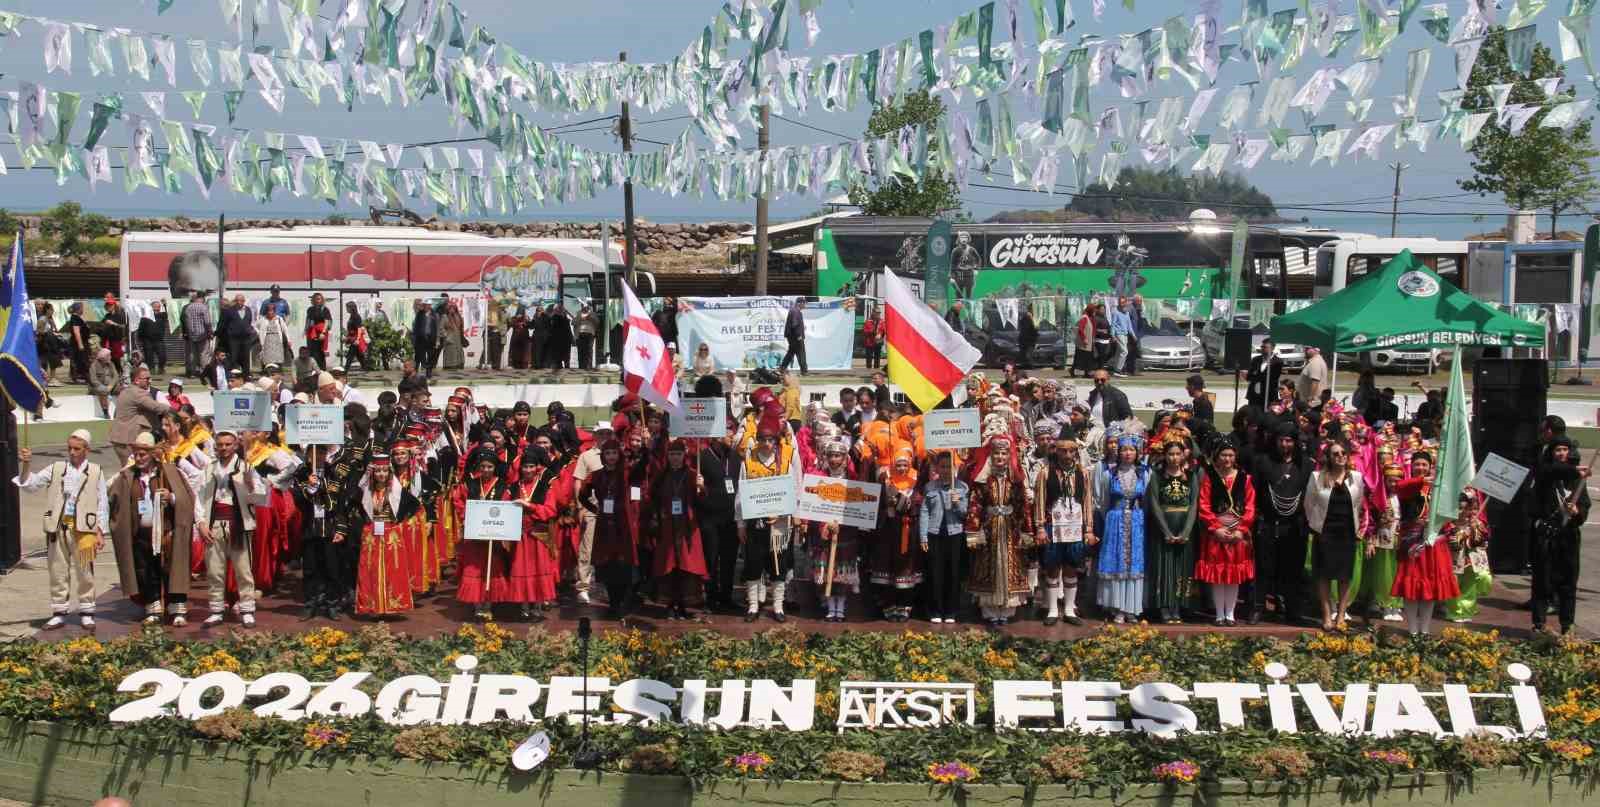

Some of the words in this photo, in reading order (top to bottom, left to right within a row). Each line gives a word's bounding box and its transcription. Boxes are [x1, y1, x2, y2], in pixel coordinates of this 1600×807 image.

[989, 237, 1104, 268] Giresun
[721, 325, 751, 334] AKSU
[1376, 332, 1429, 347] GİRESUN
[1432, 329, 1502, 345] BELEDİYESİ
[109, 668, 373, 723] 2026
[376, 655, 817, 731] GİRESUN
[837, 685, 976, 729] AKSU
[993, 662, 1548, 739] FESTİVALİ
